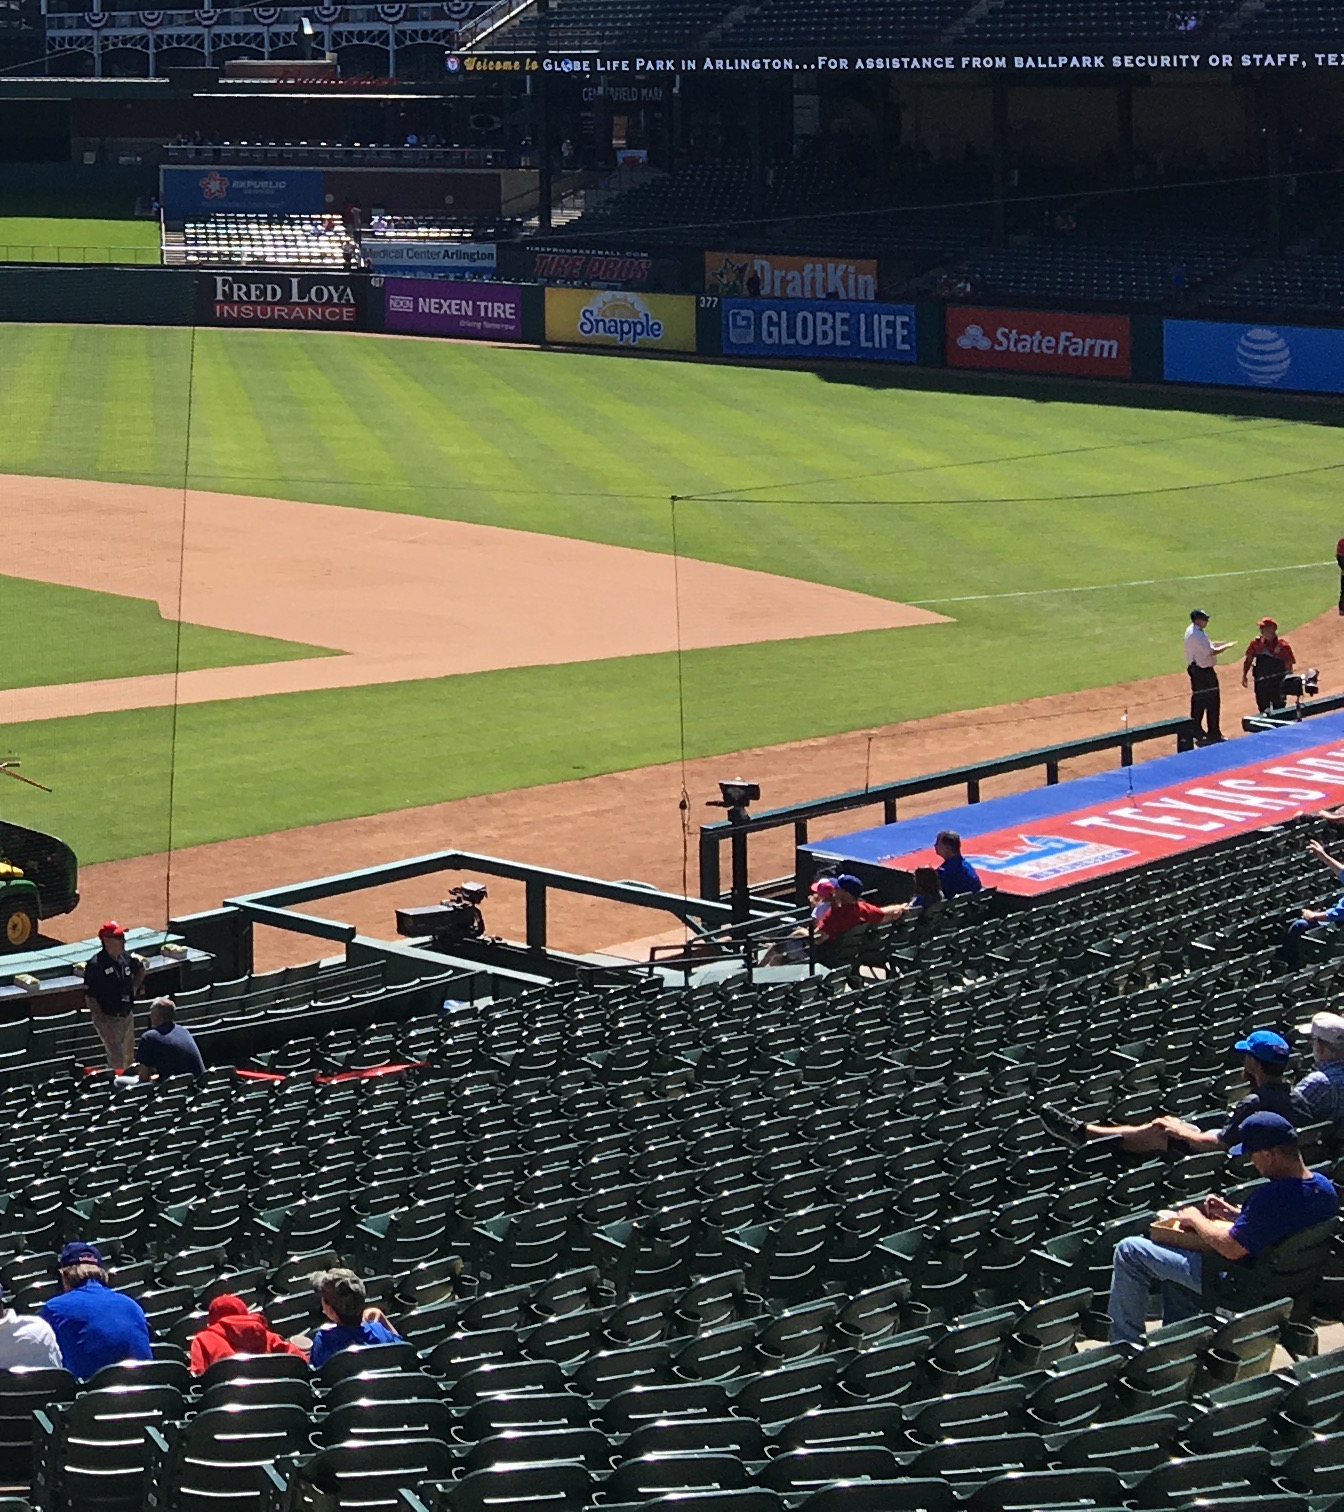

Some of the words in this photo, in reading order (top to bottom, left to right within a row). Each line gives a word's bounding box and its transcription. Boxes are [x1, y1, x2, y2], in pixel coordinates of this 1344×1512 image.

[464, 57, 520, 72] Welcome
[524, 58, 538, 71] to
[543, 58, 590, 72] GLOBE
[596, 57, 629, 71] LIFE
[636, 58, 675, 71] PARK
[681, 59, 696, 71] IN
[855, 57, 955, 70] ASSISTANCE
[961, 56, 1007, 69] FROM
[1014, 55, 1105, 69] BALLPARK
[1112, 55, 1201, 68] SECURITY
[1208, 55, 1233, 68] OR
[1241, 54, 1306, 69] STAFF,
[443, 250, 495, 263] Arlington
[534, 254, 586, 278] TIRE
[585, 257, 652, 281] PROS
[214, 275, 282, 303] FRED
[288, 277, 356, 304] LOYA
[216, 305, 354, 321] INSURANCE
[418, 297, 473, 316] NEXEN
[476, 301, 515, 319] TIRE
[699, 296, 719, 308] 377
[579, 310, 663, 343] Snapple
[761, 310, 851, 348] GLOBE
[859, 312, 910, 350] LIFE
[1070, 779, 1327, 840] TEXAS
